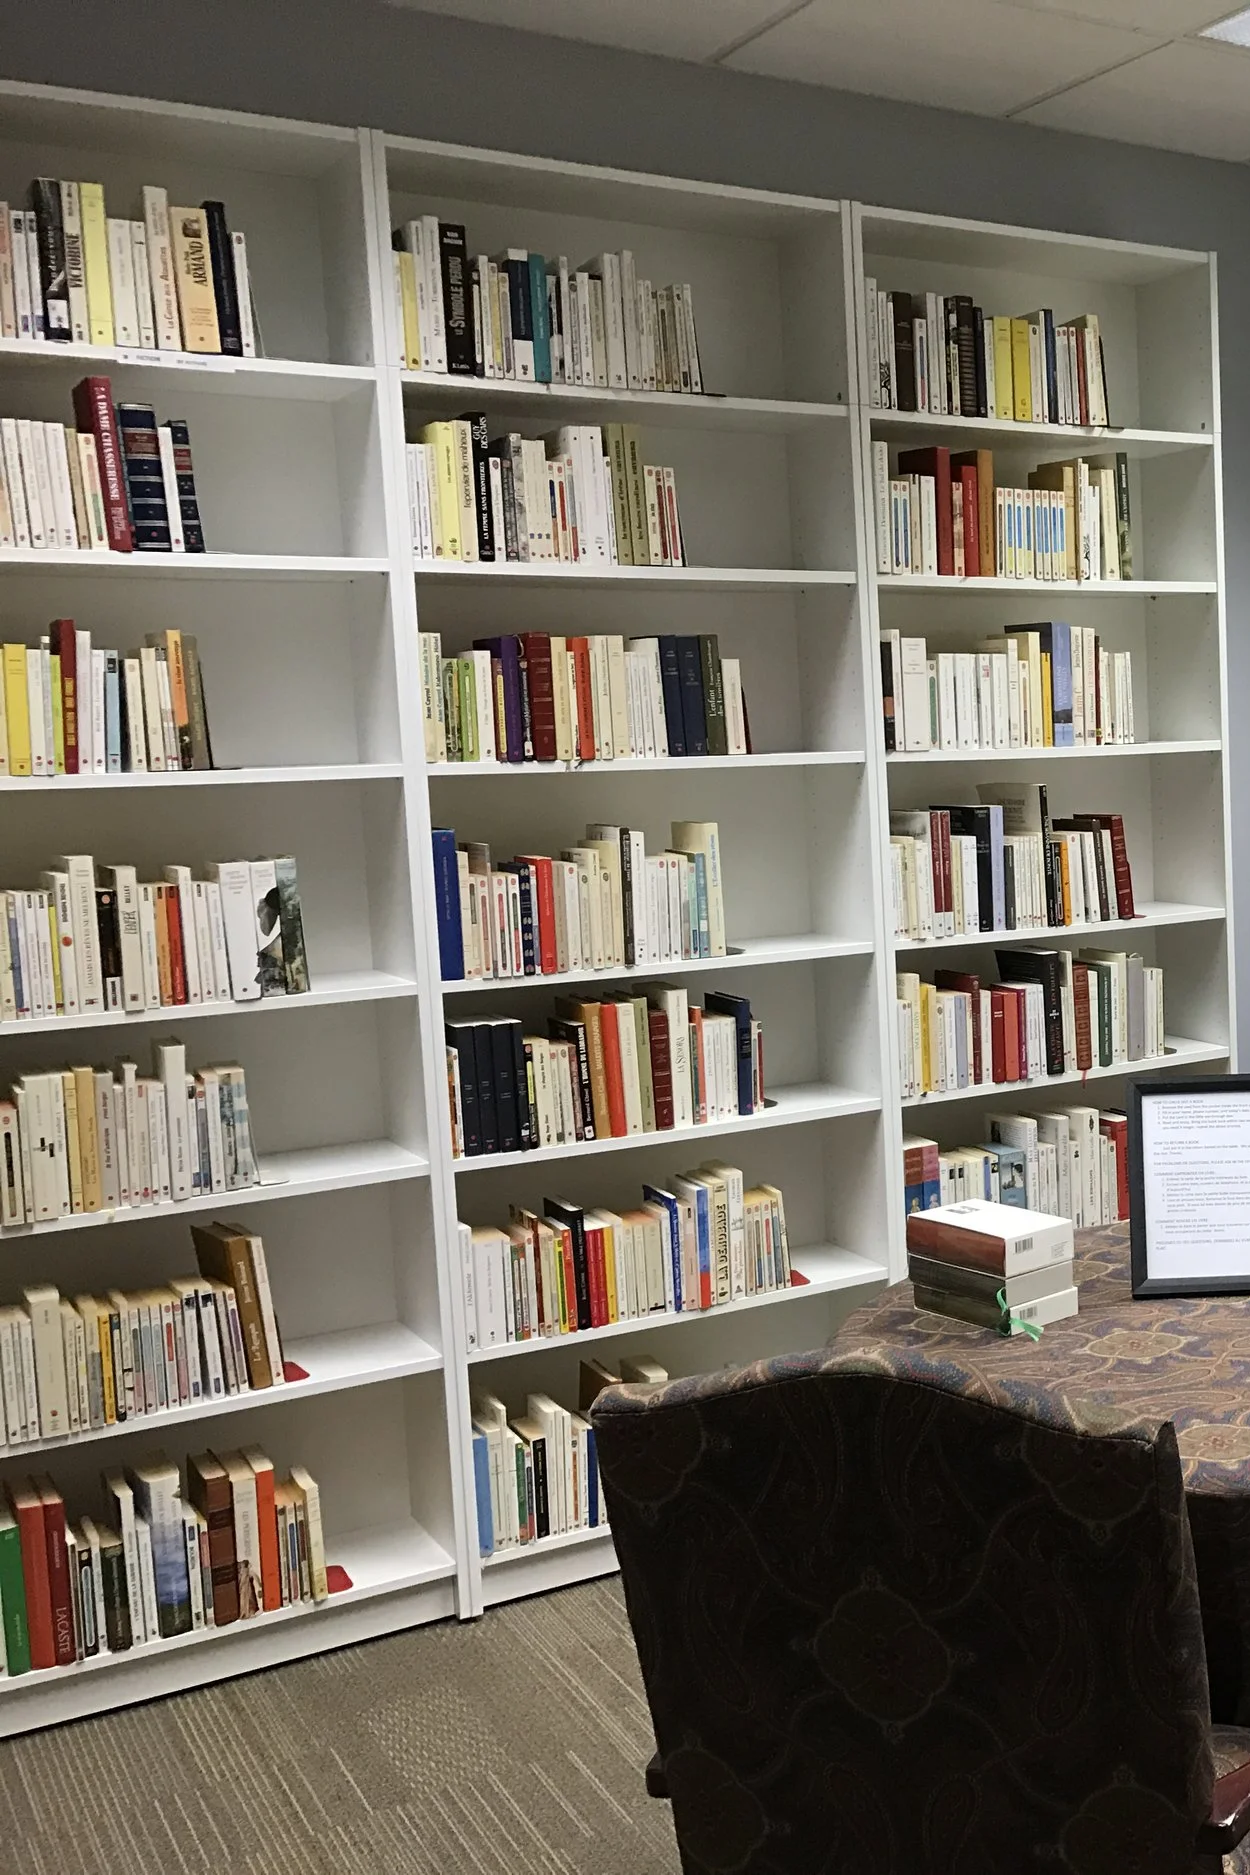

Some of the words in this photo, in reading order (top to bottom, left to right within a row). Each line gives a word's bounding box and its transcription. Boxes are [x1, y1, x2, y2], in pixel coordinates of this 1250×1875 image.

[66, 231, 83, 289] VICTORINE
[188, 241, 208, 288] ARMAND
[448, 256, 462, 284] PERDU
[448, 286, 466, 328] SYMBOLE
[471, 424, 480, 440] GUY
[479, 416, 488, 436] CARS
[480, 435, 489, 449] DES
[708, 689, 717, 717] L'enfant
[82, 918, 89, 928] NE
[84, 949, 92, 963] LES
[86, 962, 94, 985] JAMAIS
[717, 1265, 728, 1282] LA
